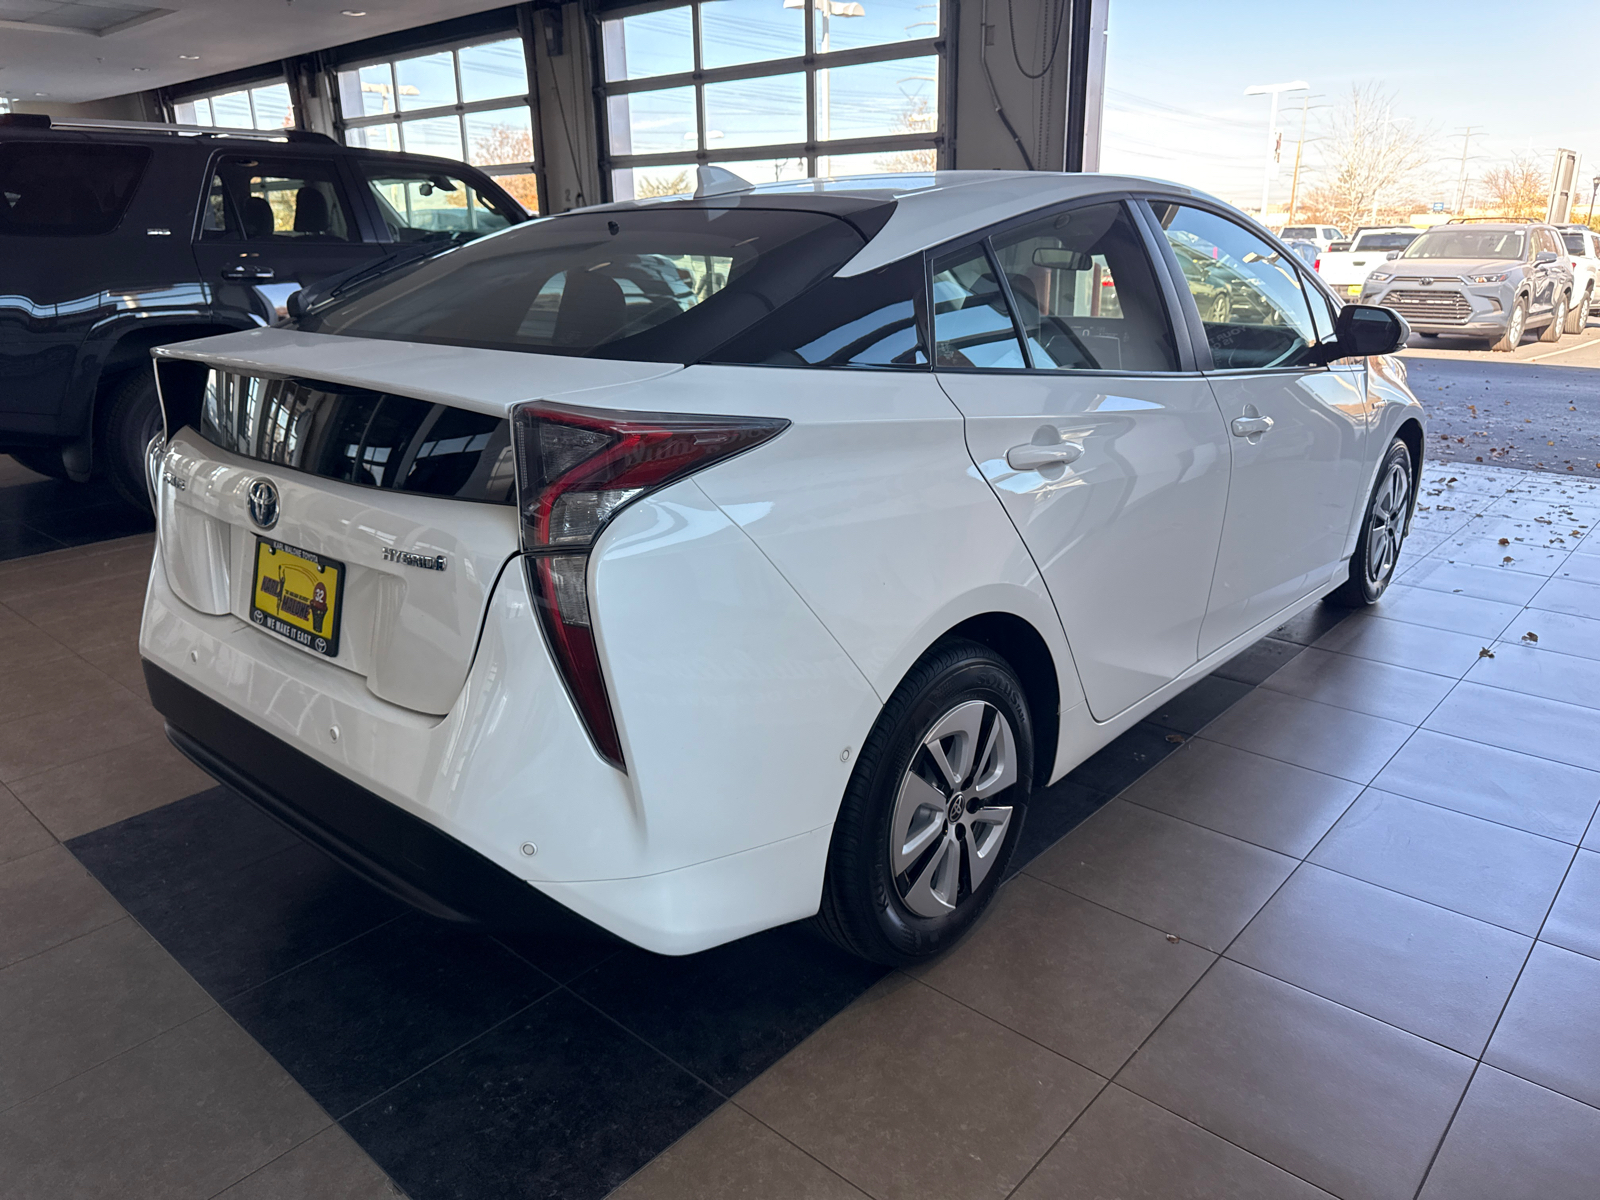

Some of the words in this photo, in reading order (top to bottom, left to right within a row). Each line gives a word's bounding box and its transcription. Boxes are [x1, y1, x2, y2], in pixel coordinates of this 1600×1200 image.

[382, 547, 436, 569] HYBRID
[315, 588, 325, 603] 32
[267, 616, 276, 629] WE
[275, 620, 291, 636] MAKE
[290, 627, 297, 639] IT
[296, 629, 312, 646] EASY
[976, 672, 1019, 705] SOLUS
